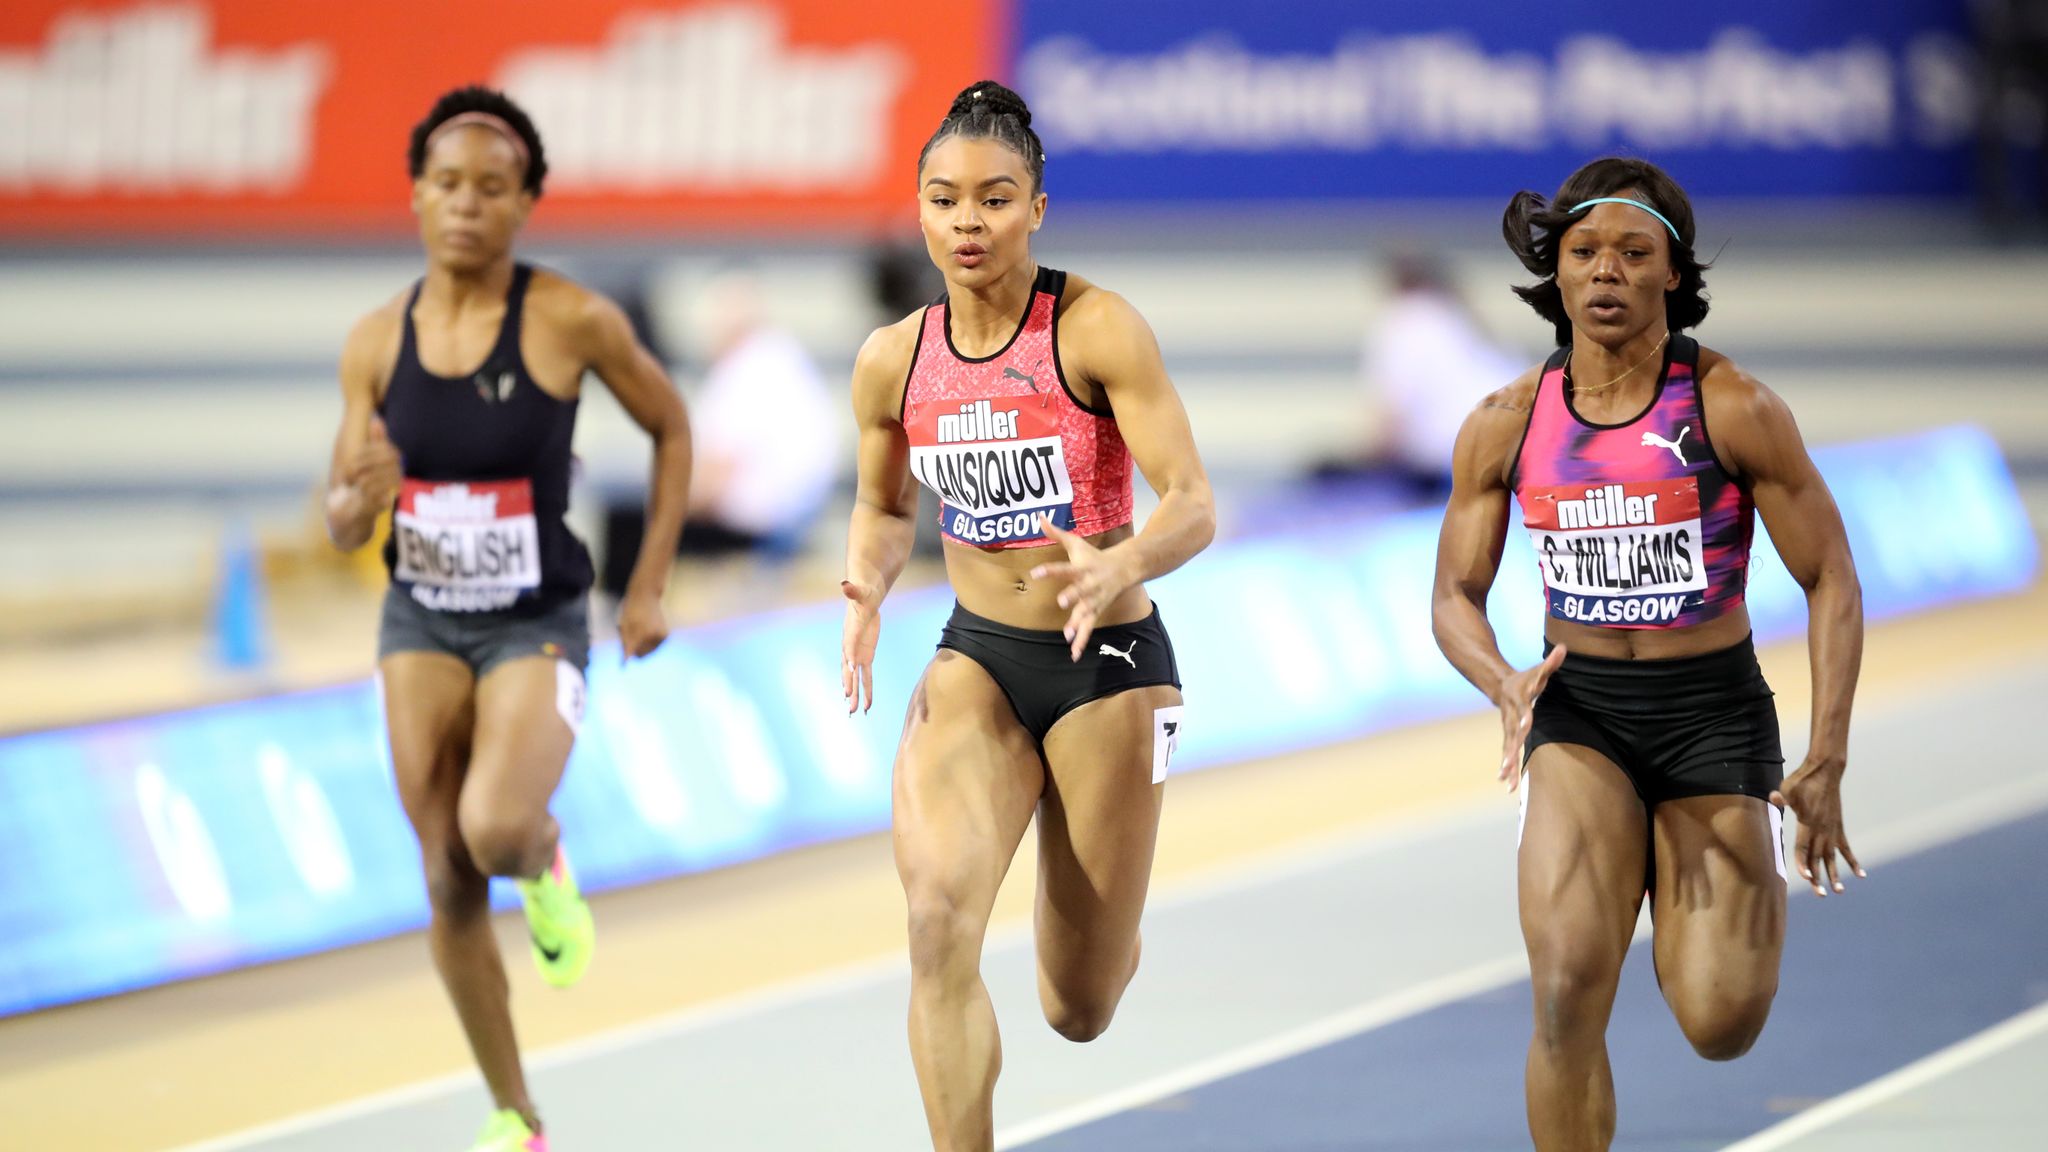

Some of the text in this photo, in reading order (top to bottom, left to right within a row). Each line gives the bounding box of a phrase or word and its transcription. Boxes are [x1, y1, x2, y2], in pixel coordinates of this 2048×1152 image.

[936, 399, 1020, 444] müller
[920, 446, 1060, 511] LANSIQUOT
[952, 508, 1057, 543] GLASGOW
[1556, 484, 1658, 530] müller
[403, 526, 528, 579] ENGLISH
[1543, 528, 1694, 589] C. WILLIAMS
[1563, 595, 1687, 623] GLASGOW
